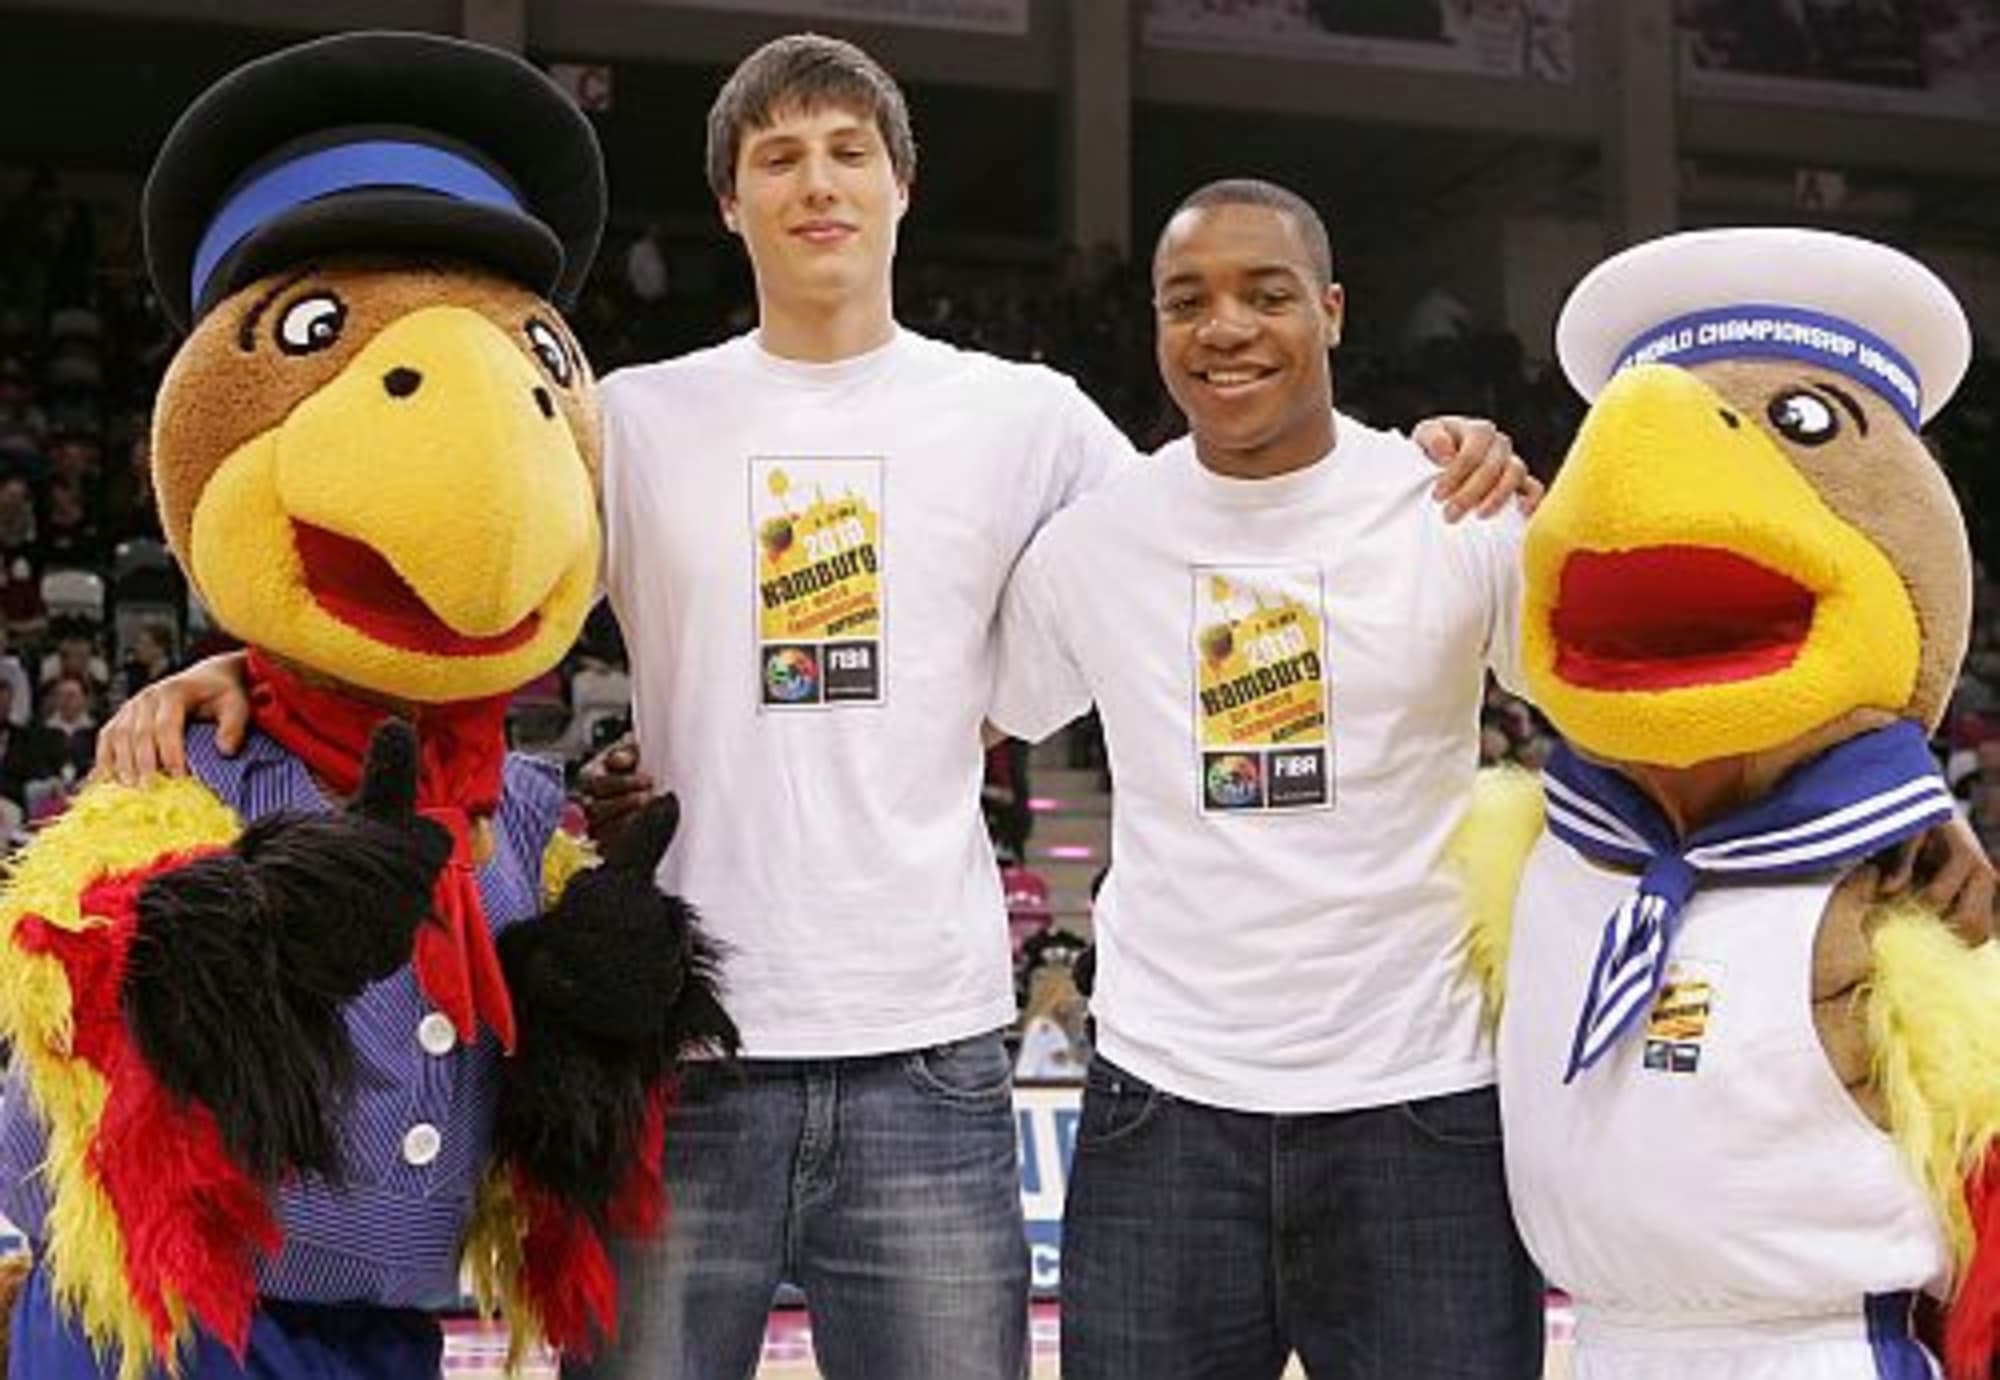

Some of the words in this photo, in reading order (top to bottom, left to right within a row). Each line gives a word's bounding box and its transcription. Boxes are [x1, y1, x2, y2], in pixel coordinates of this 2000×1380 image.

[1698, 318, 1857, 358] CHAMPIONSHIP
[803, 516, 865, 562] 2010
[1274, 754, 1318, 777] FIBA
